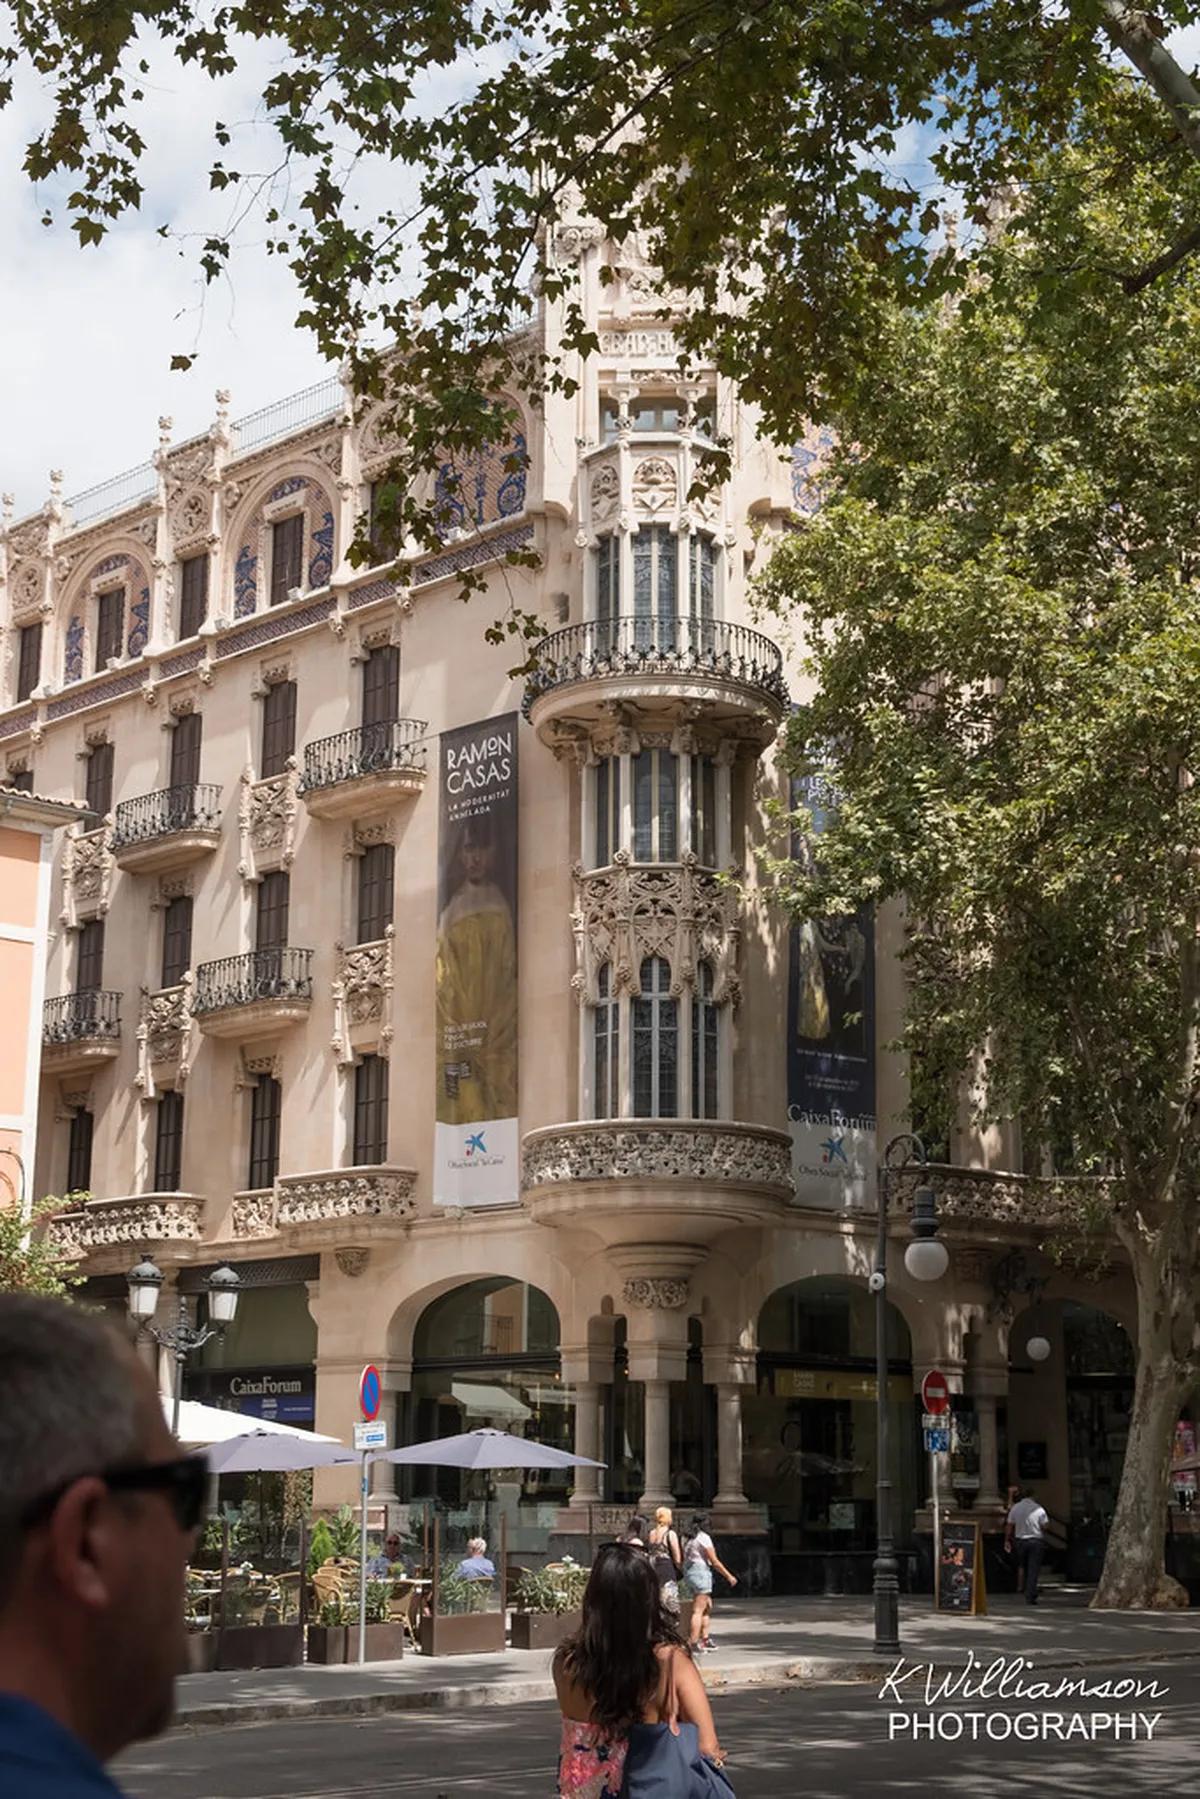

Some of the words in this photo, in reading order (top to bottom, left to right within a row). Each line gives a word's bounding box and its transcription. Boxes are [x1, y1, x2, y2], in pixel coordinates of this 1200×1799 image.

[447, 732, 512, 770] RAMON
[447, 758, 511, 794] CASAS
[230, 1376, 302, 1396] CaixaForum
